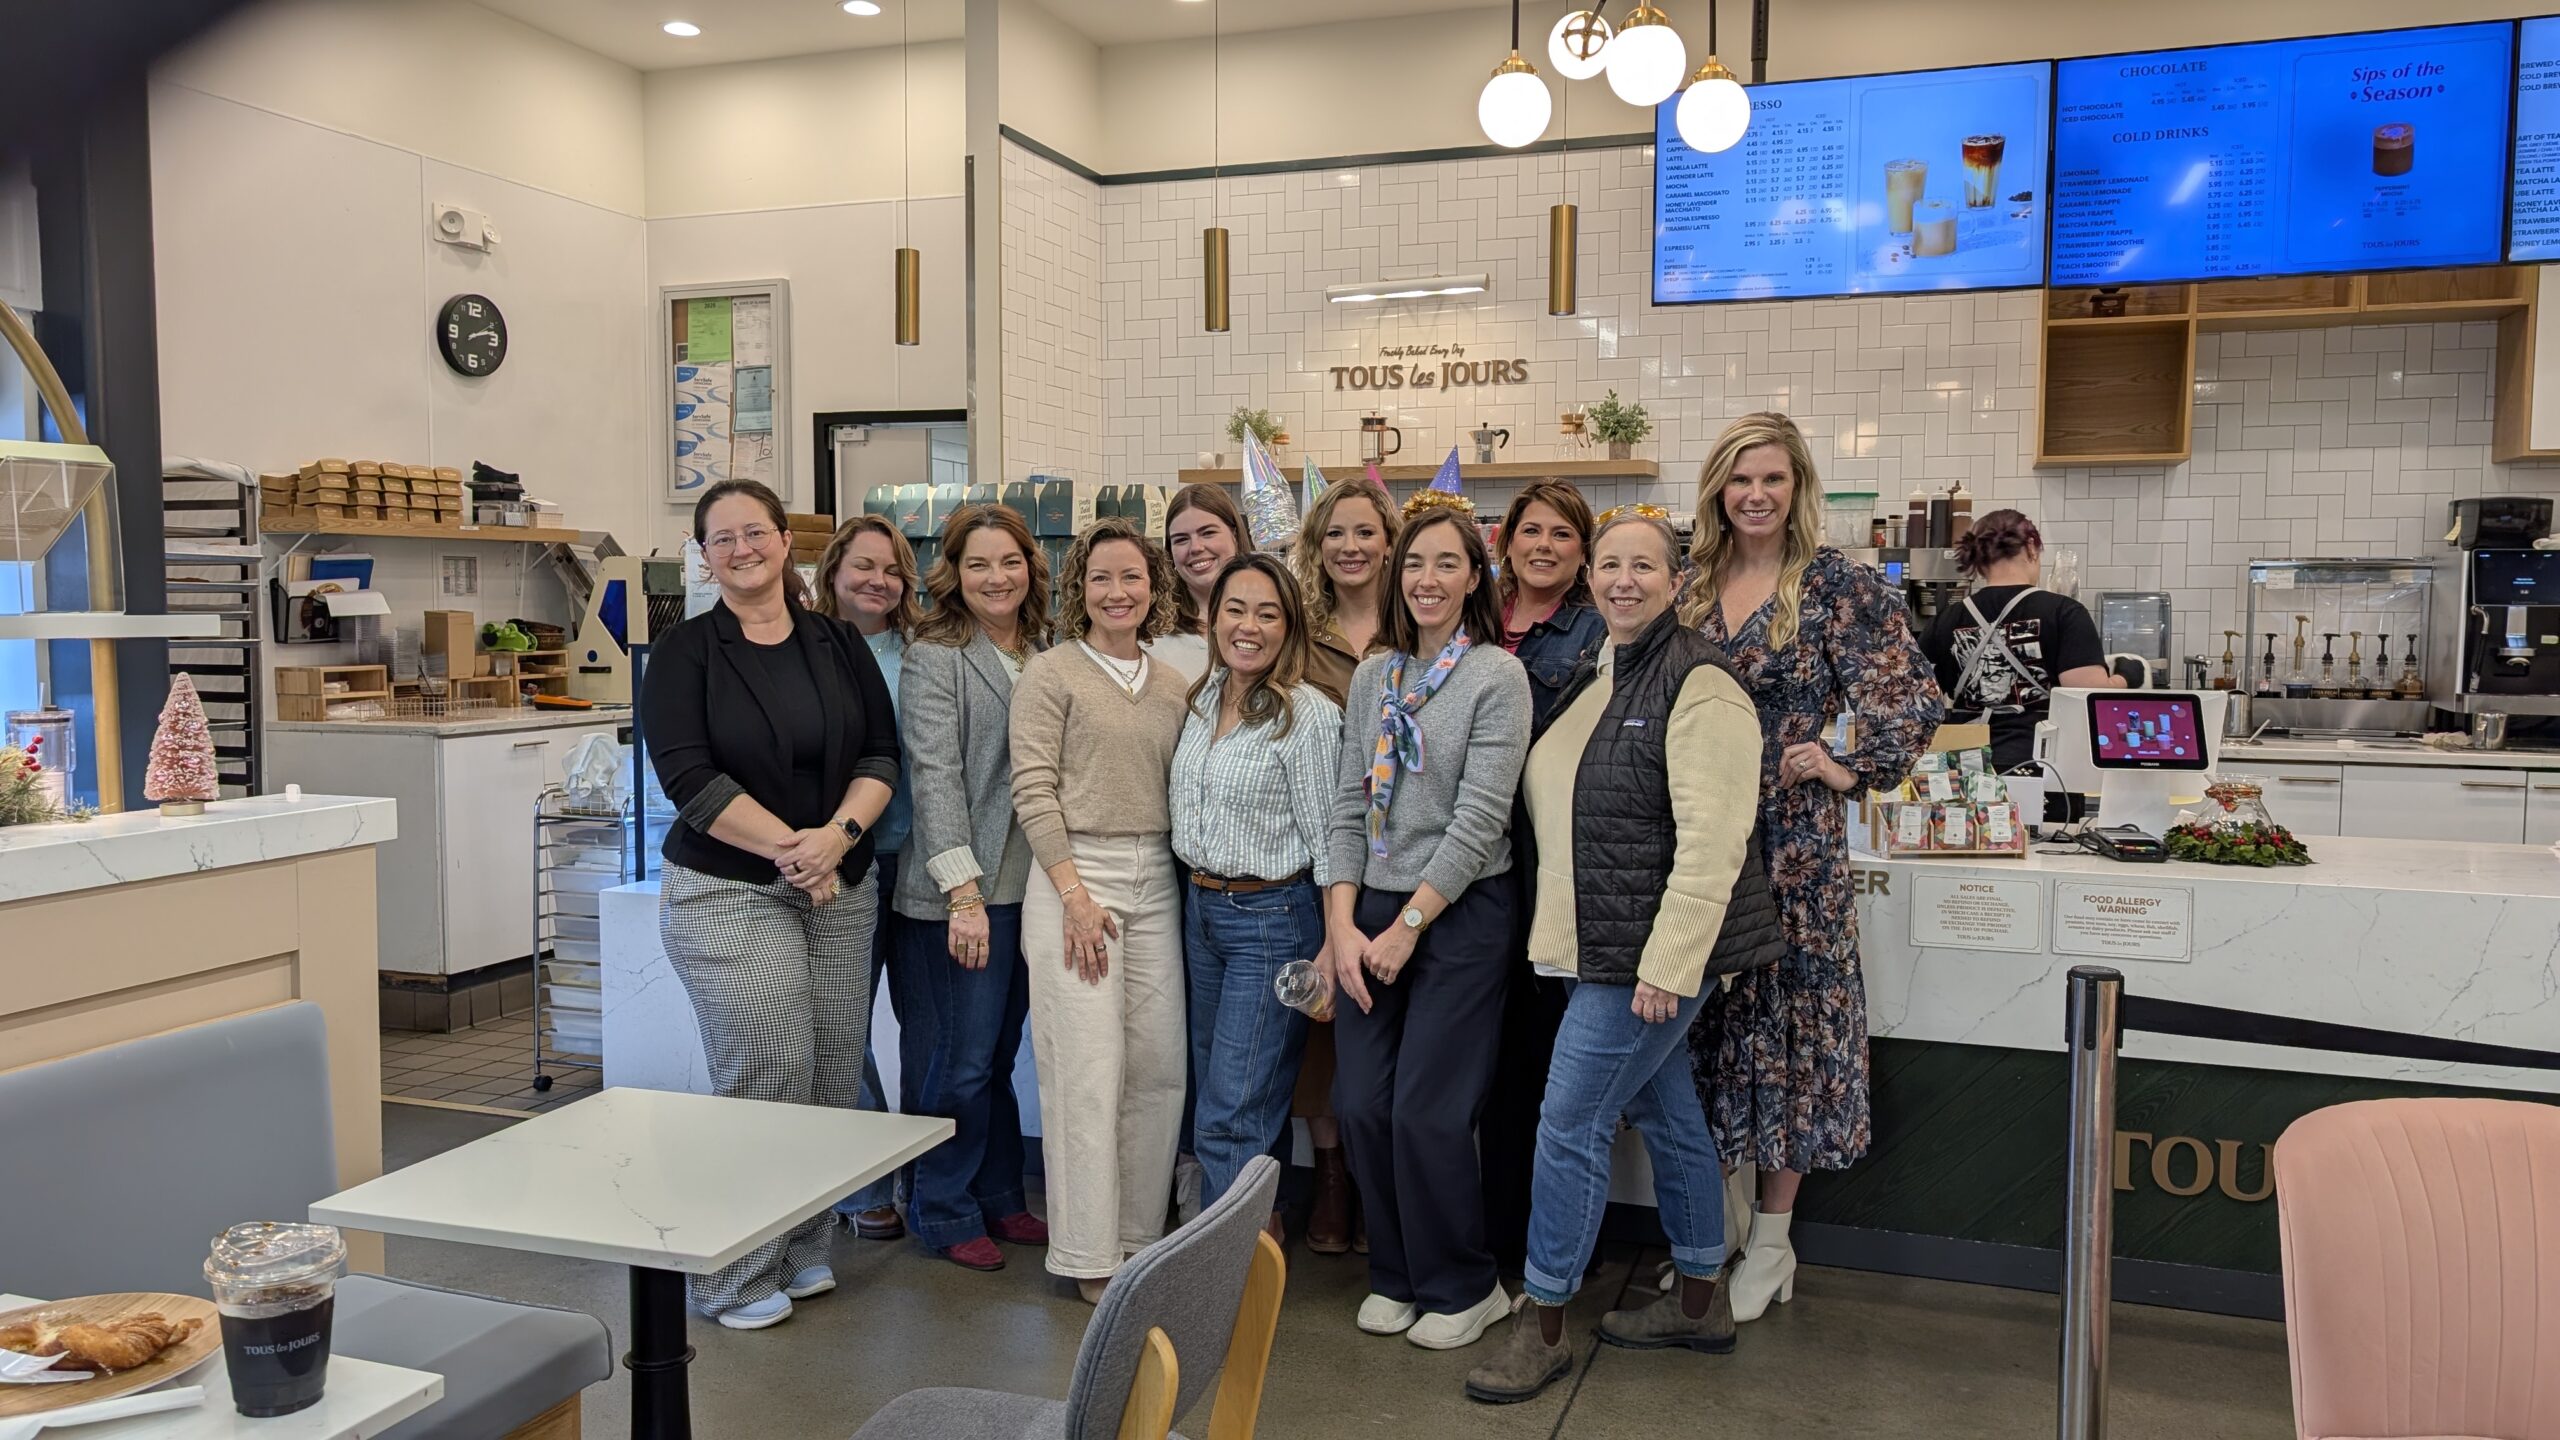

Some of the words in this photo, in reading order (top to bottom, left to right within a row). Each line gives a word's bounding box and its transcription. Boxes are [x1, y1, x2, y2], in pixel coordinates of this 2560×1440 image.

[2120, 61, 2208, 78] CHOCOLATE
[2520, 61, 2553, 69] BREWED
[2352, 66, 2387, 86] Sips
[2392, 62, 2414, 79] of
[2416, 60, 2445, 76] the
[2360, 86, 2432, 102] Season
[1751, 100, 1782, 111] ESSO
[2079, 102, 2122, 111] CHOCOLATE
[2080, 112, 2124, 121] CHOCOLATE
[2112, 131, 2151, 144] COLD
[2156, 126, 2209, 140] DRINKS
[2060, 169, 2099, 177] LEMONADE
[2060, 179, 2106, 188] STRAWBERRY
[2108, 176, 2149, 184] LEMONADE
[2513, 217, 2560, 225] STRAWBERR
[2058, 231, 2104, 239] STRAWBERRY
[2513, 228, 2560, 236] STRAWBERR
[467, 302, 482, 318] 12
[448, 324, 458, 338] 9
[488, 331, 498, 347] 3
[468, 354, 478, 368] 6
[1330, 364, 1404, 390] TOUS
[1410, 363, 1435, 387] les
[1440, 358, 1529, 392] JOURS
[1852, 870, 1890, 896] ER
[1960, 884, 1995, 893] NOTICE
[2083, 895, 2113, 904] FOOD
[2116, 897, 2161, 907] ALLERGY
[2097, 904, 2148, 915] WARNING
[2114, 1131, 2275, 1202] TOU
[243, 1345, 275, 1355] TOUS
[276, 1343, 288, 1352] les
[288, 1332, 320, 1352] JOURS
